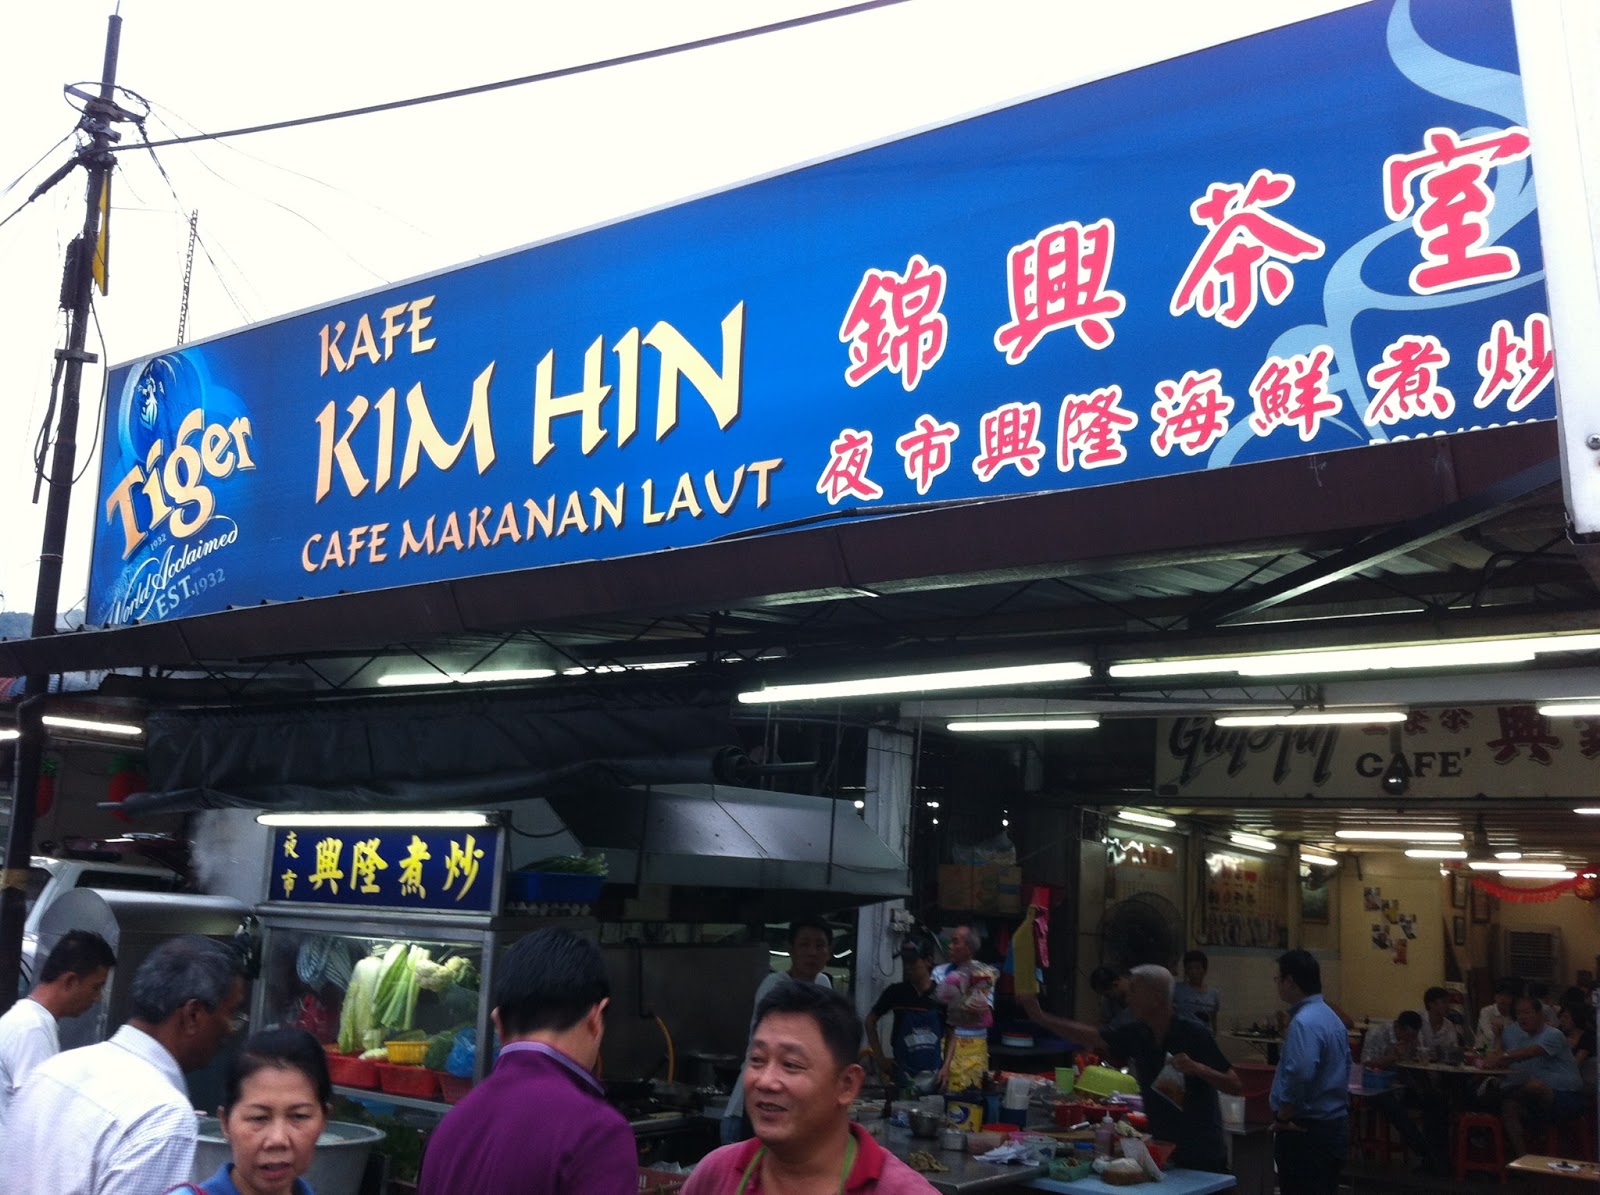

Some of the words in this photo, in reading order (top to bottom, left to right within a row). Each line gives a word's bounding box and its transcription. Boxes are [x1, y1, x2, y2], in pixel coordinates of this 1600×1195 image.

[838, 126, 1530, 392] 錦興茶室
[318, 294, 437, 378] KAFE
[314, 360, 497, 505] KIM
[532, 300, 746, 466] HIN
[816, 313, 1553, 506] 夜市興隆海鮮煮炒
[105, 408, 257, 561] Tiger
[301, 522, 392, 574] CAFE
[399, 482, 626, 562] MAKANAN
[641, 457, 784, 526] LAUT
[136, 515, 238, 621] Acclaimed
[281, 830, 300, 898] 夜市
[308, 833, 485, 901] 興隆煮炒
